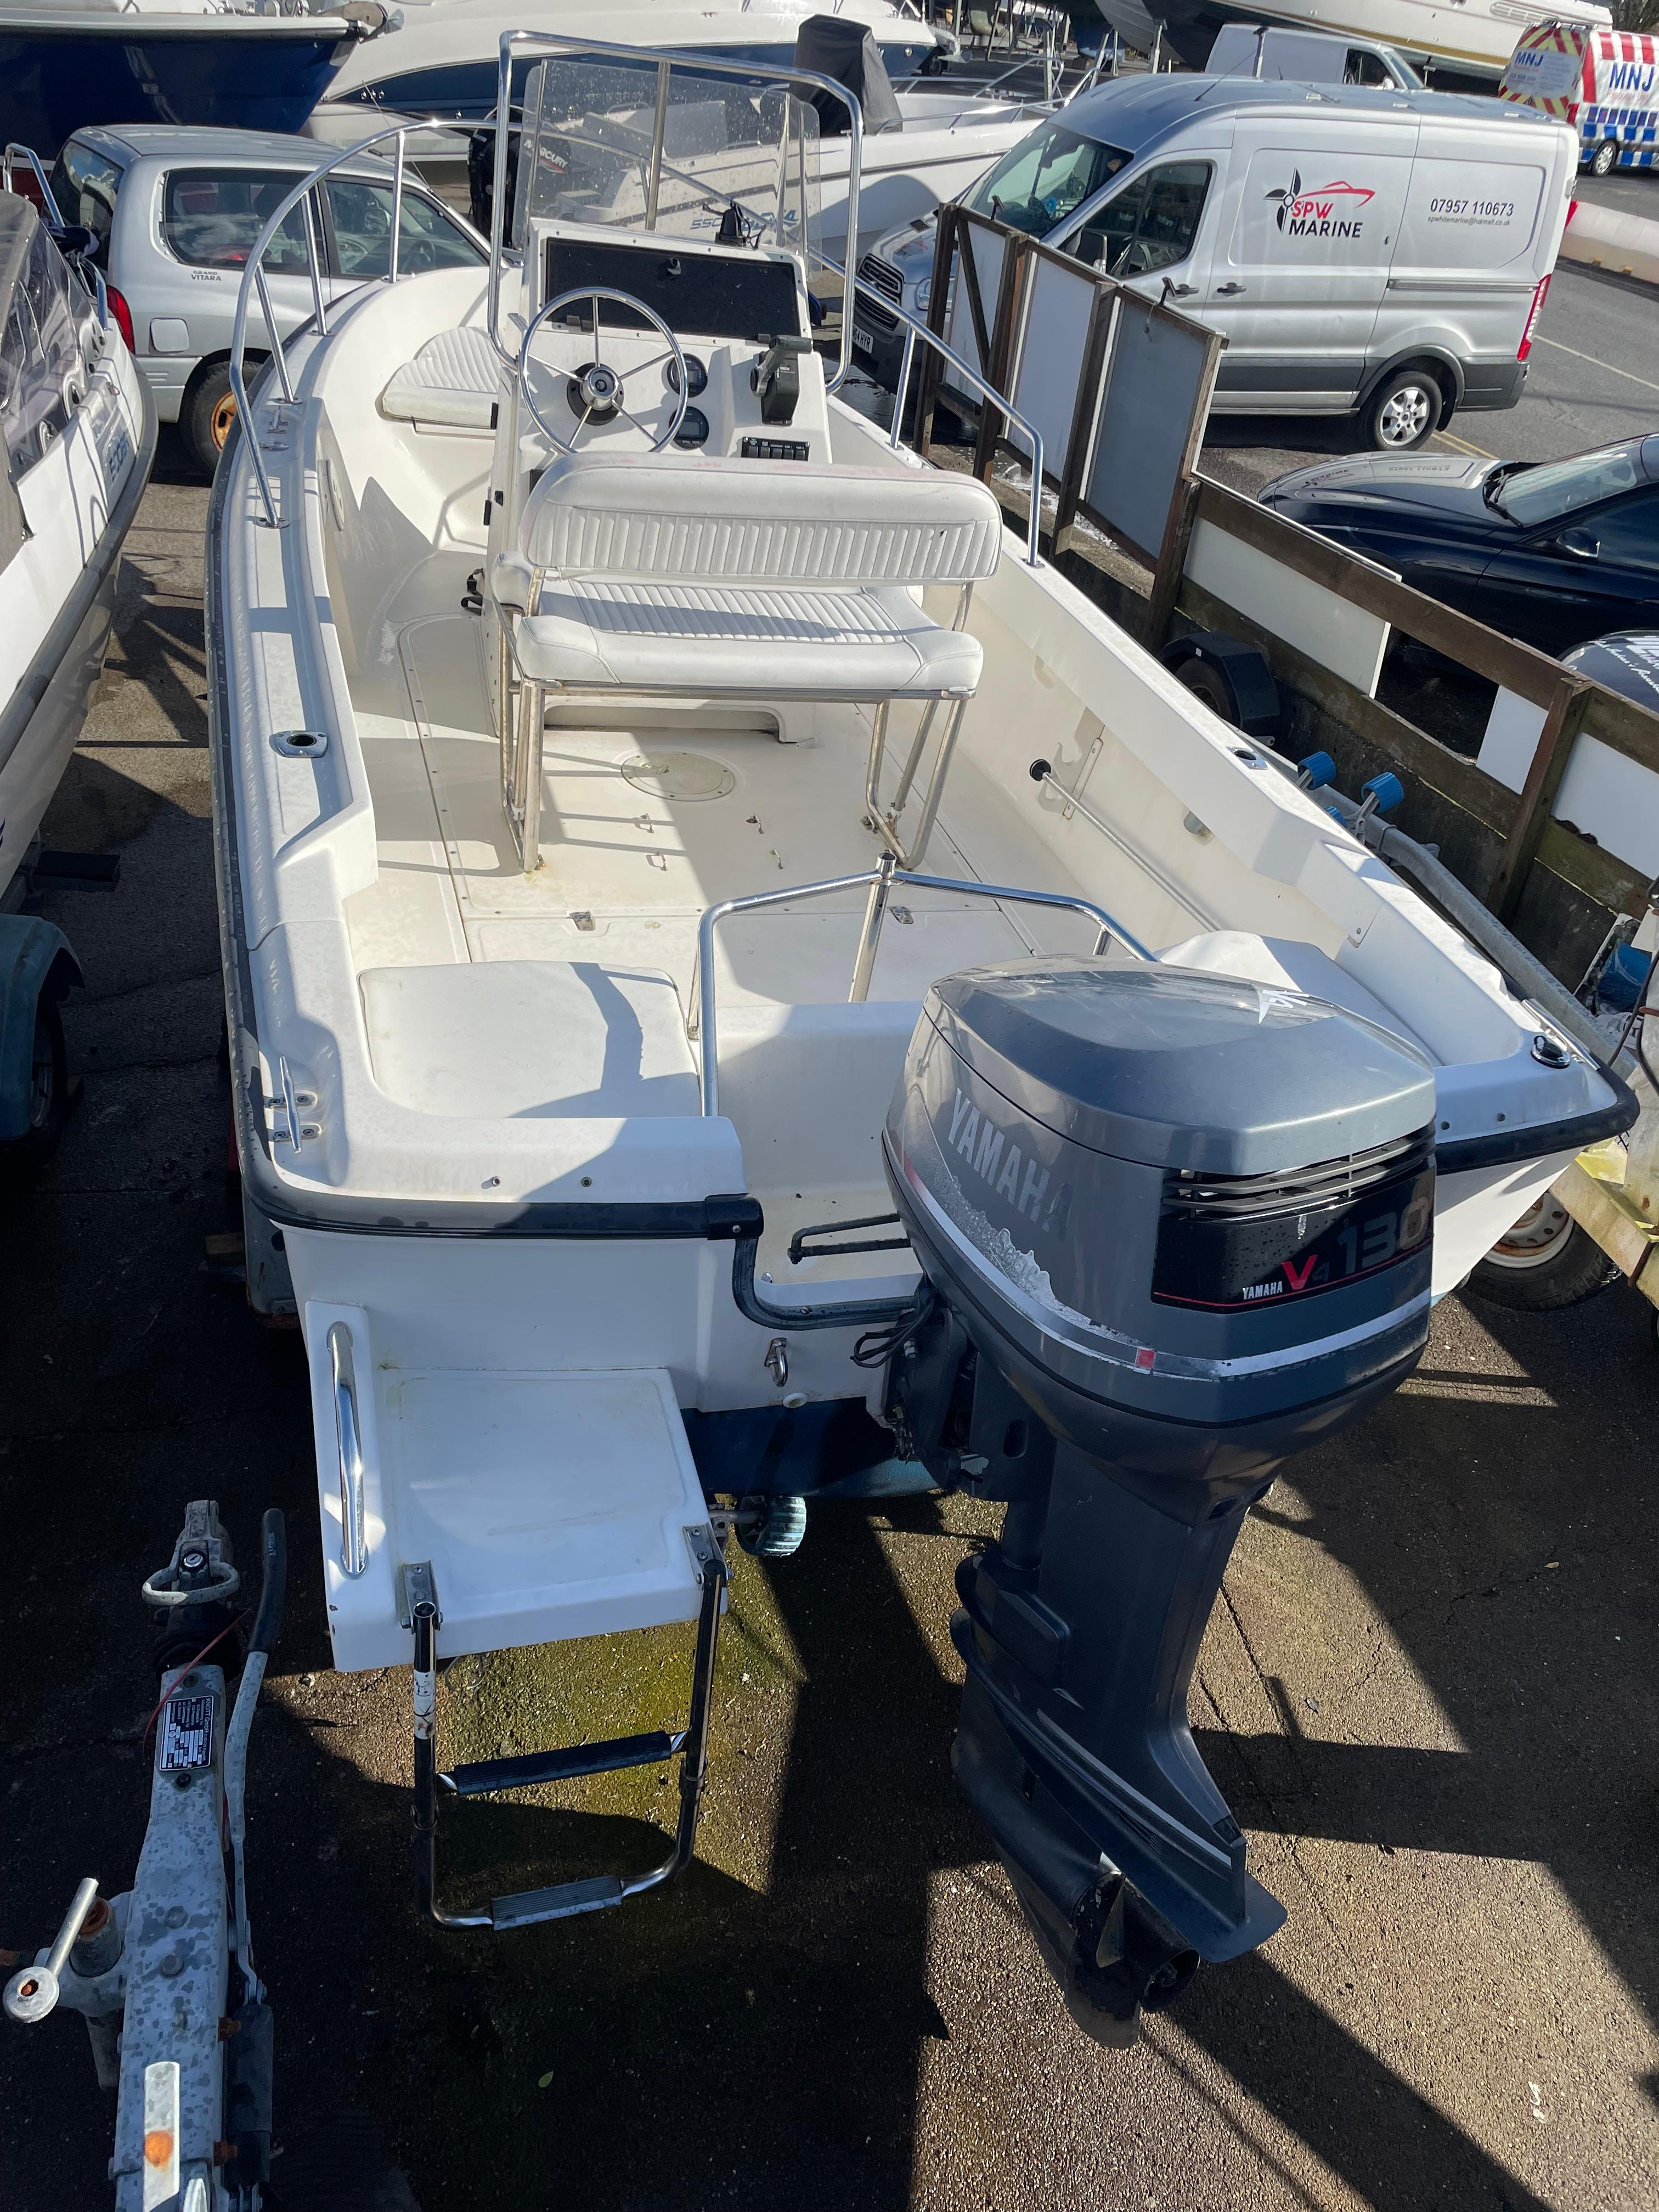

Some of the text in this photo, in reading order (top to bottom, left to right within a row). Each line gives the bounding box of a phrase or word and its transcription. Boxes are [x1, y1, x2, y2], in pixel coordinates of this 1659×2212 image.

[1515, 52, 1544, 66] MNJ
[1609, 62, 1655, 92] MNJ
[523, 139, 569, 168] MRCURY
[1291, 201, 1334, 219] SPW
[1430, 198, 1514, 217] 07957 110673
[1289, 219, 1363, 238] MARINE
[860, 332, 871, 350] HYR
[1243, 1280, 1283, 1300] YAMAHA
[1338, 1196, 1432, 1275] 130
